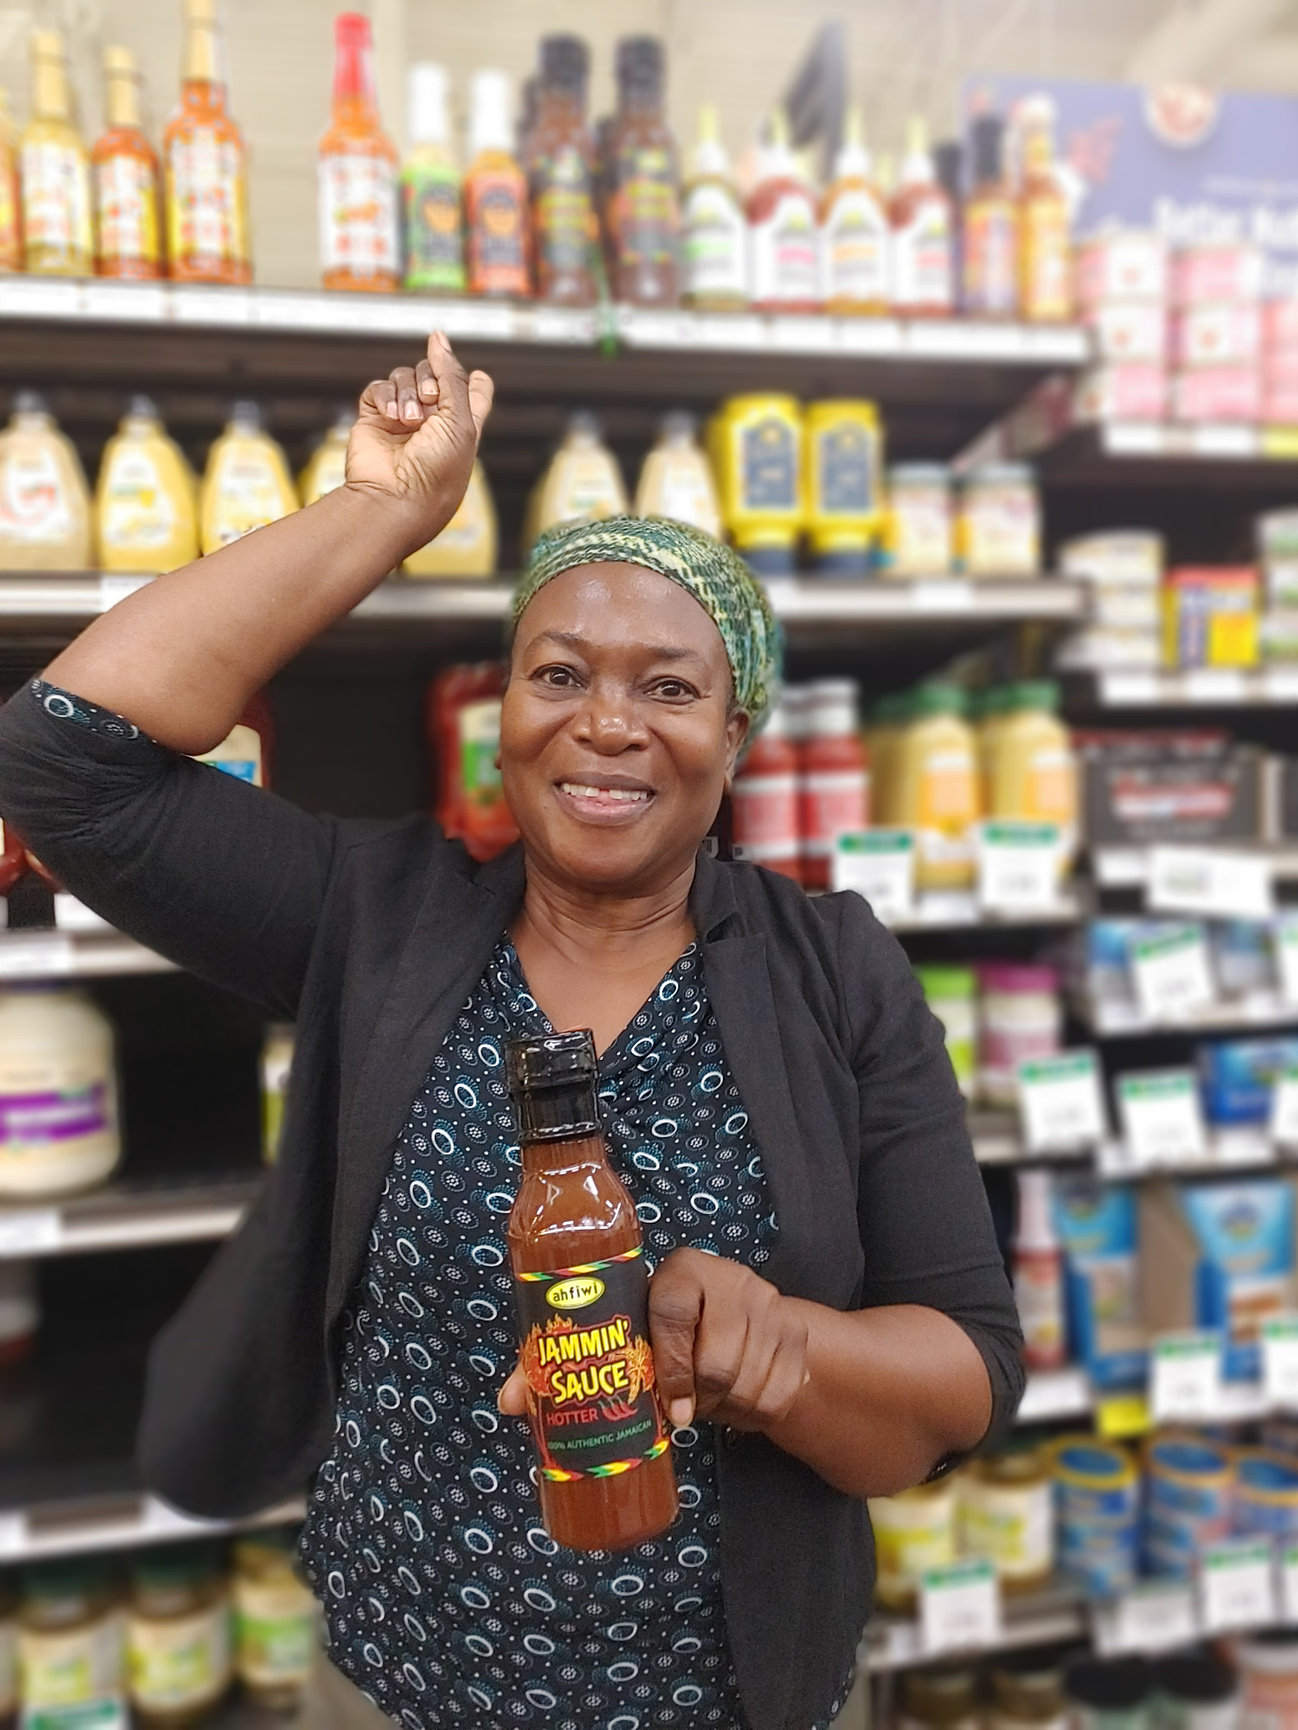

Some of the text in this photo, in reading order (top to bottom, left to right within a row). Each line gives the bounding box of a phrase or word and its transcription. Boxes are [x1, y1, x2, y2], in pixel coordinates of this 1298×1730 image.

[552, 1281, 599, 1302] ahfiwi
[538, 1318, 629, 1366] JAMMIN'
[551, 1360, 629, 1404] SAUCE
[546, 1408, 599, 1425] HOTTER
[566, 1434, 614, 1449] AUTHENTIC
[615, 1419, 652, 1440] JAMAICAN
